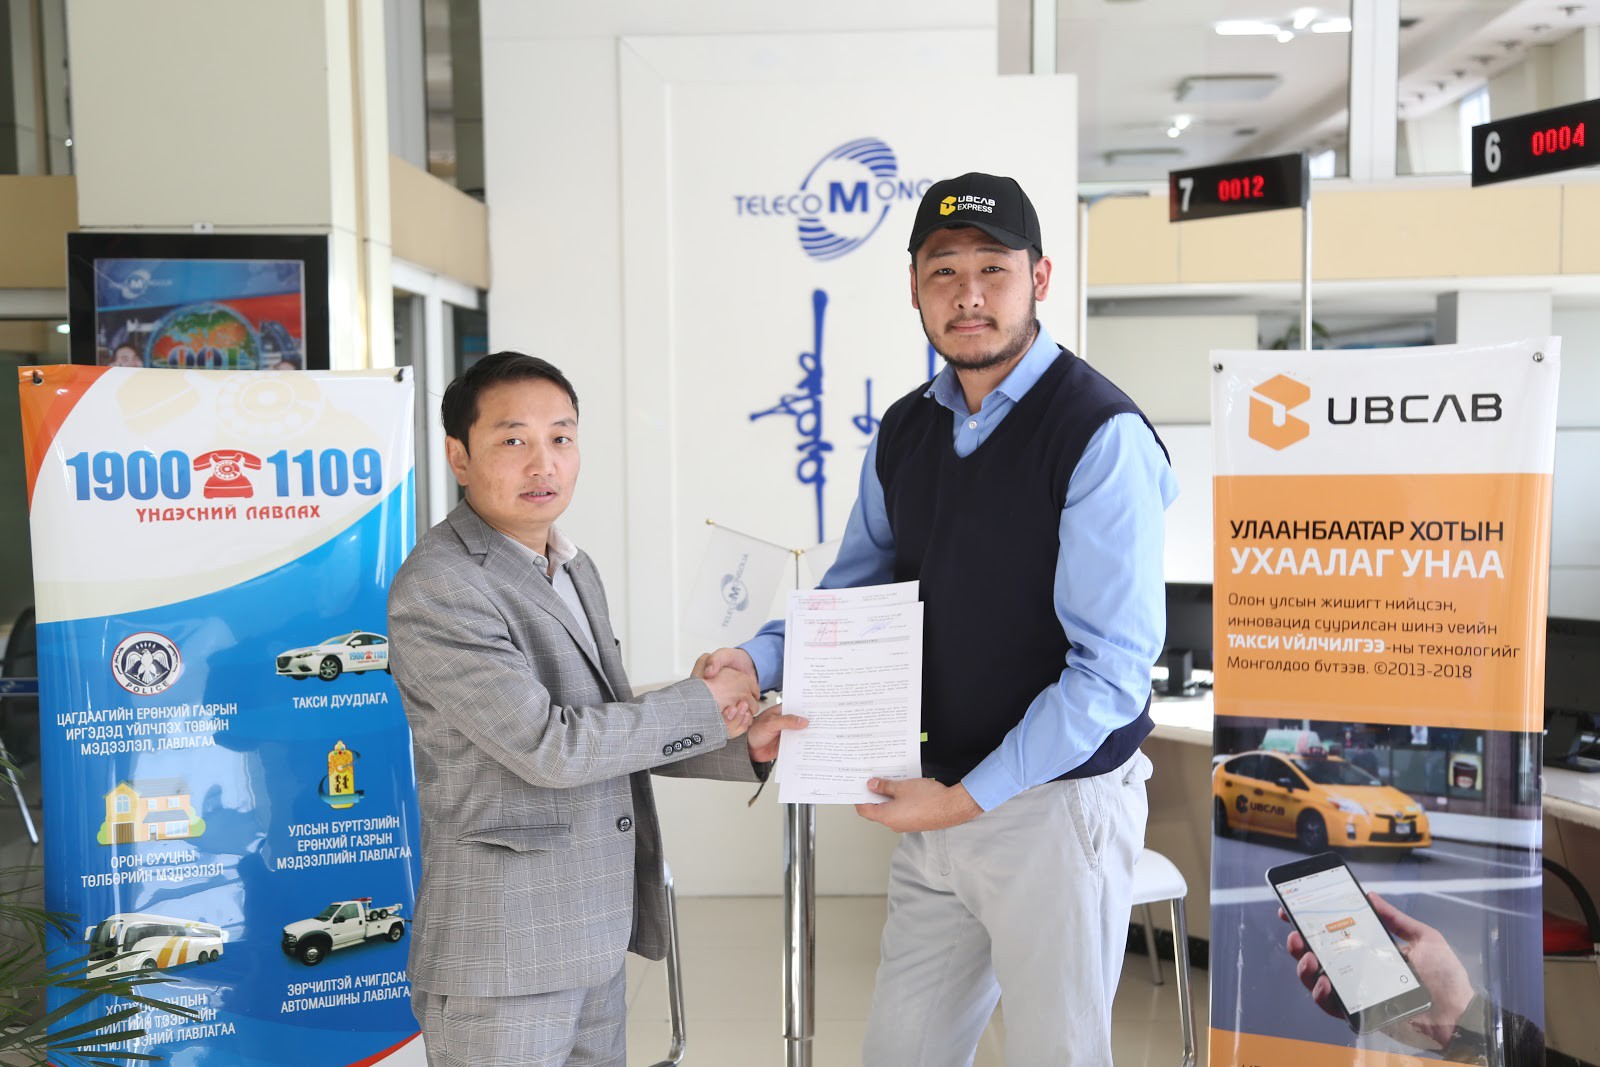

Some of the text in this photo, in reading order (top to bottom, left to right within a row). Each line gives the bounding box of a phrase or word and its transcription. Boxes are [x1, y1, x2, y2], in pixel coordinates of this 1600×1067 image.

[1484, 122, 1585, 173] 6 0004
[958, 195, 995, 206] UBCAB
[1178, 175, 1264, 212] 7 0012
[957, 203, 993, 213] EXPRESS
[1327, 393, 1503, 424] UBCAB
[66, 448, 383, 500] 1900 1109
[136, 504, 320, 523] ҮНДЭСНИЙ ЛАВЛАХ
[1230, 520, 1504, 541] УЛААНБААТАР ХОТЫН
[1230, 547, 1505, 578] УХААЛАГ УНАА
[1228, 592, 1457, 613] Олон улсын жишигт нийцсэн,
[1228, 617, 1310, 630] инновацид
[1315, 619, 1397, 633] суурилсан
[1401, 621, 1443, 633] шинэ
[1227, 633, 1279, 649] ТАКСИ
[1418, 642, 1520, 658] технологийг
[1227, 655, 1310, 672] Монголдоо
[126, 681, 169, 694] POLICE
[292, 692, 388, 709] ТАКСИ ДУУДЛАГА
[57, 703, 238, 727] ЦАГДААГИЙН ЕРӨНХИЙ ГАЗРЫН
[66, 718, 229, 741] ИРГЭДЭД ҮЙЛЧЛЭХ ТӨВИЙН
[81, 736, 216, 755] МЭДЭЭЛЭЛ, ЛАВЛАГАА
[1249, 802, 1285, 816] UBCAB
[288, 815, 400, 837] УЛСЫН БҮРТГЭЛИЙН
[297, 832, 393, 852] ЕРӨНХИЙ ГАЗРЫН
[111, 850, 195, 869] ОРОН СУУЦНЫ
[277, 846, 412, 870] МЭДЭЭЛЛИЙН ЛАВЛАГАА
[81, 863, 224, 888] ТӨЛБӨРИЙН МЭДЭЭЛЭЛ
[287, 975, 352, 997] ЗӨРЧИЛТЭЙ
[280, 986, 412, 1013] АВТОМАШИНЫ ЛАВЛАГА
[176, 1022, 235, 1042] ЛАВЛАГАА
